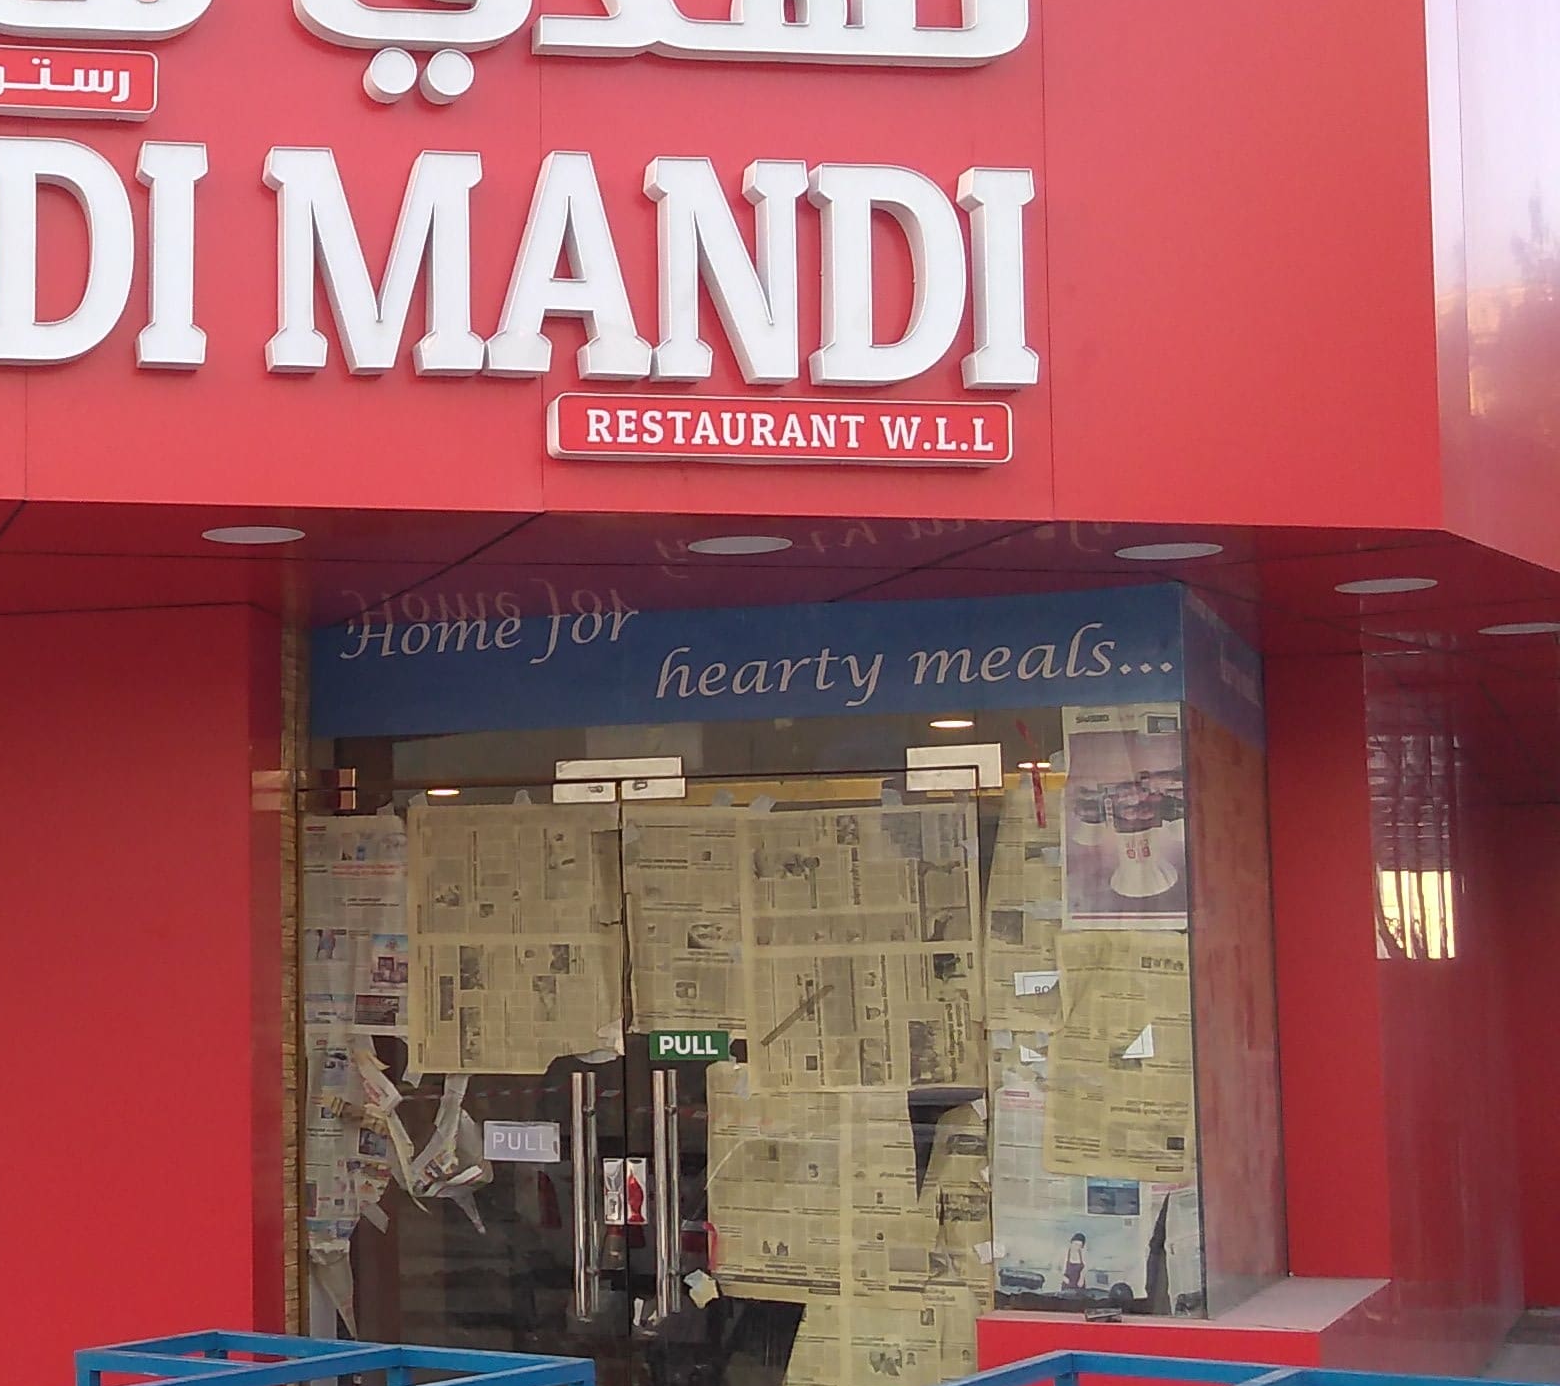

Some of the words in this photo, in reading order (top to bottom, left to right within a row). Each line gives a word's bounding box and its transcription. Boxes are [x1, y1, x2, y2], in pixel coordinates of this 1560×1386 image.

[262, 146, 1040, 390] MANDI
[586, 409, 865, 450] RESTAURANT
[880, 416, 994, 452] W.L.L
[340, 616, 522, 660] Home
[529, 610, 640, 665] for
[655, 647, 884, 707] hearty
[907, 622, 1174, 685] meals...
[659, 1035, 719, 1056] PULL
[492, 1131, 552, 1152] PULL
